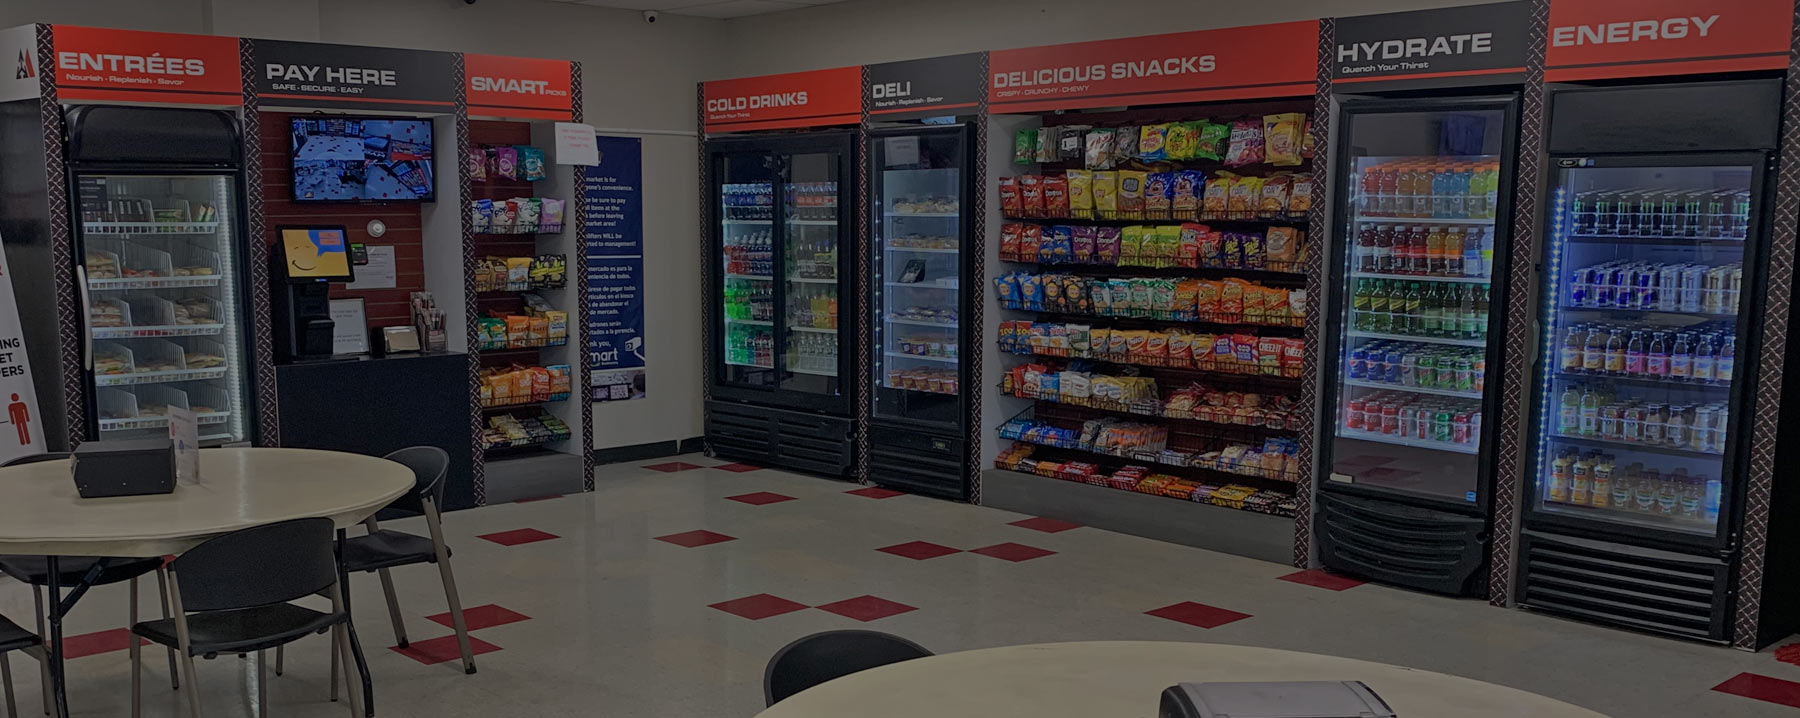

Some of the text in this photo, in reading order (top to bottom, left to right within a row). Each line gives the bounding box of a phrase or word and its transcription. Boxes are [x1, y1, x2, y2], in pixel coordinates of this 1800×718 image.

[1552, 15, 1720, 47] ENERGY
[1338, 32, 1492, 62] HYDRATE
[58, 52, 205, 76] ENTRÉES
[993, 55, 1216, 88] DELICIOUS SNACKS
[1341, 61, 1429, 74] Quench Your Thirst
[66, 73, 184, 86] Nourish Replenish Savor
[265, 63, 396, 86] PAY HERE
[272, 83, 364, 94] SAFE SECURE EASY
[471, 76, 548, 95] SMART
[872, 81, 911, 99] DELI
[1024, 87, 1058, 96] CRUNCHY
[1062, 85, 1090, 93] CHEWY
[707, 91, 808, 112] COLD DRINKS
[875, 100, 897, 108] Nourish
[0, 365, 24, 377] ERS
